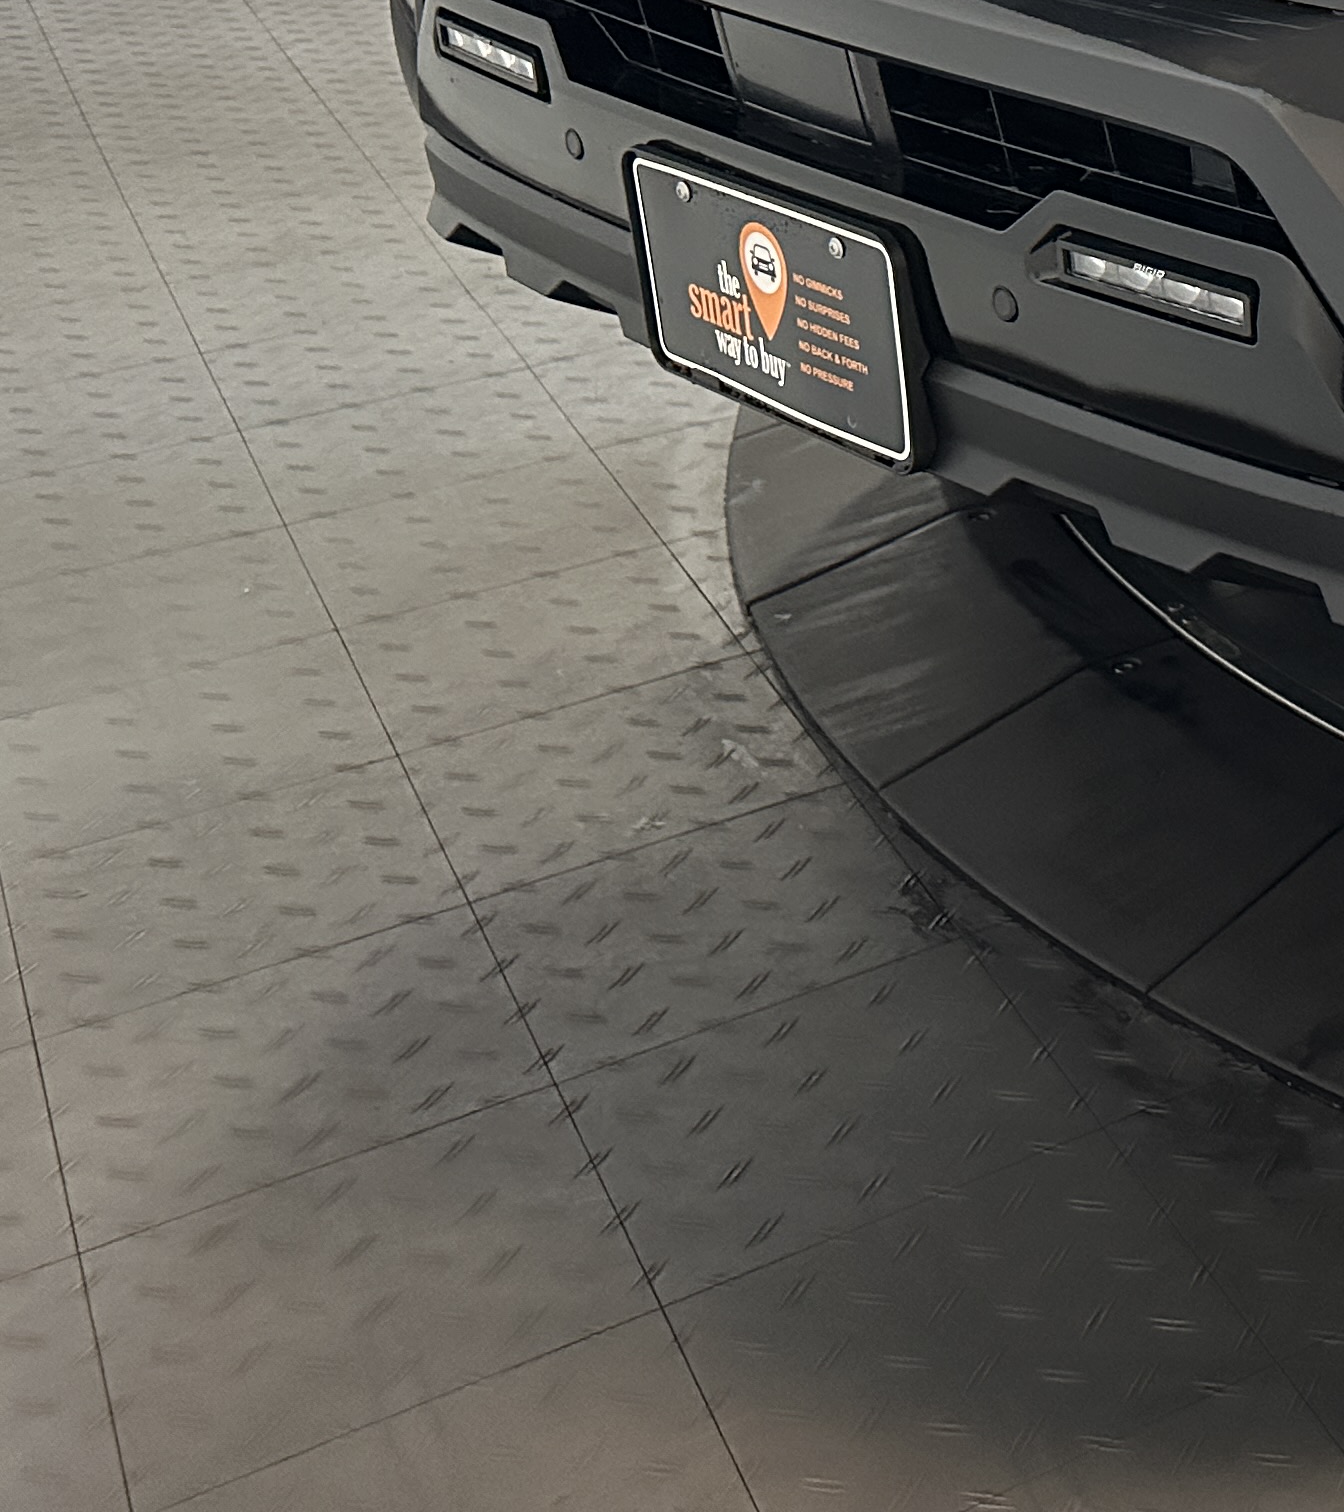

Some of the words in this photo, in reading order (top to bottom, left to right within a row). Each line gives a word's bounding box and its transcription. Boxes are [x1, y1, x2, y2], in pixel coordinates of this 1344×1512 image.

[717, 259, 741, 299] the
[792, 272, 805, 286] NO
[688, 283, 754, 341] smart
[794, 294, 807, 308] NO
[807, 299, 851, 326] SURPRISES
[714, 329, 742, 366] way
[742, 336, 759, 369] to
[796, 317, 809, 331] NO
[809, 322, 839, 342] HIDDEN
[838, 333, 860, 351] FEES
[798, 339, 811, 353] NO
[810, 343, 834, 362] BACK
[834, 353, 841, 365] &
[840, 355, 869, 376] FORTH
[800, 361, 812, 375] NO
[812, 366, 854, 392] PRESSURE
